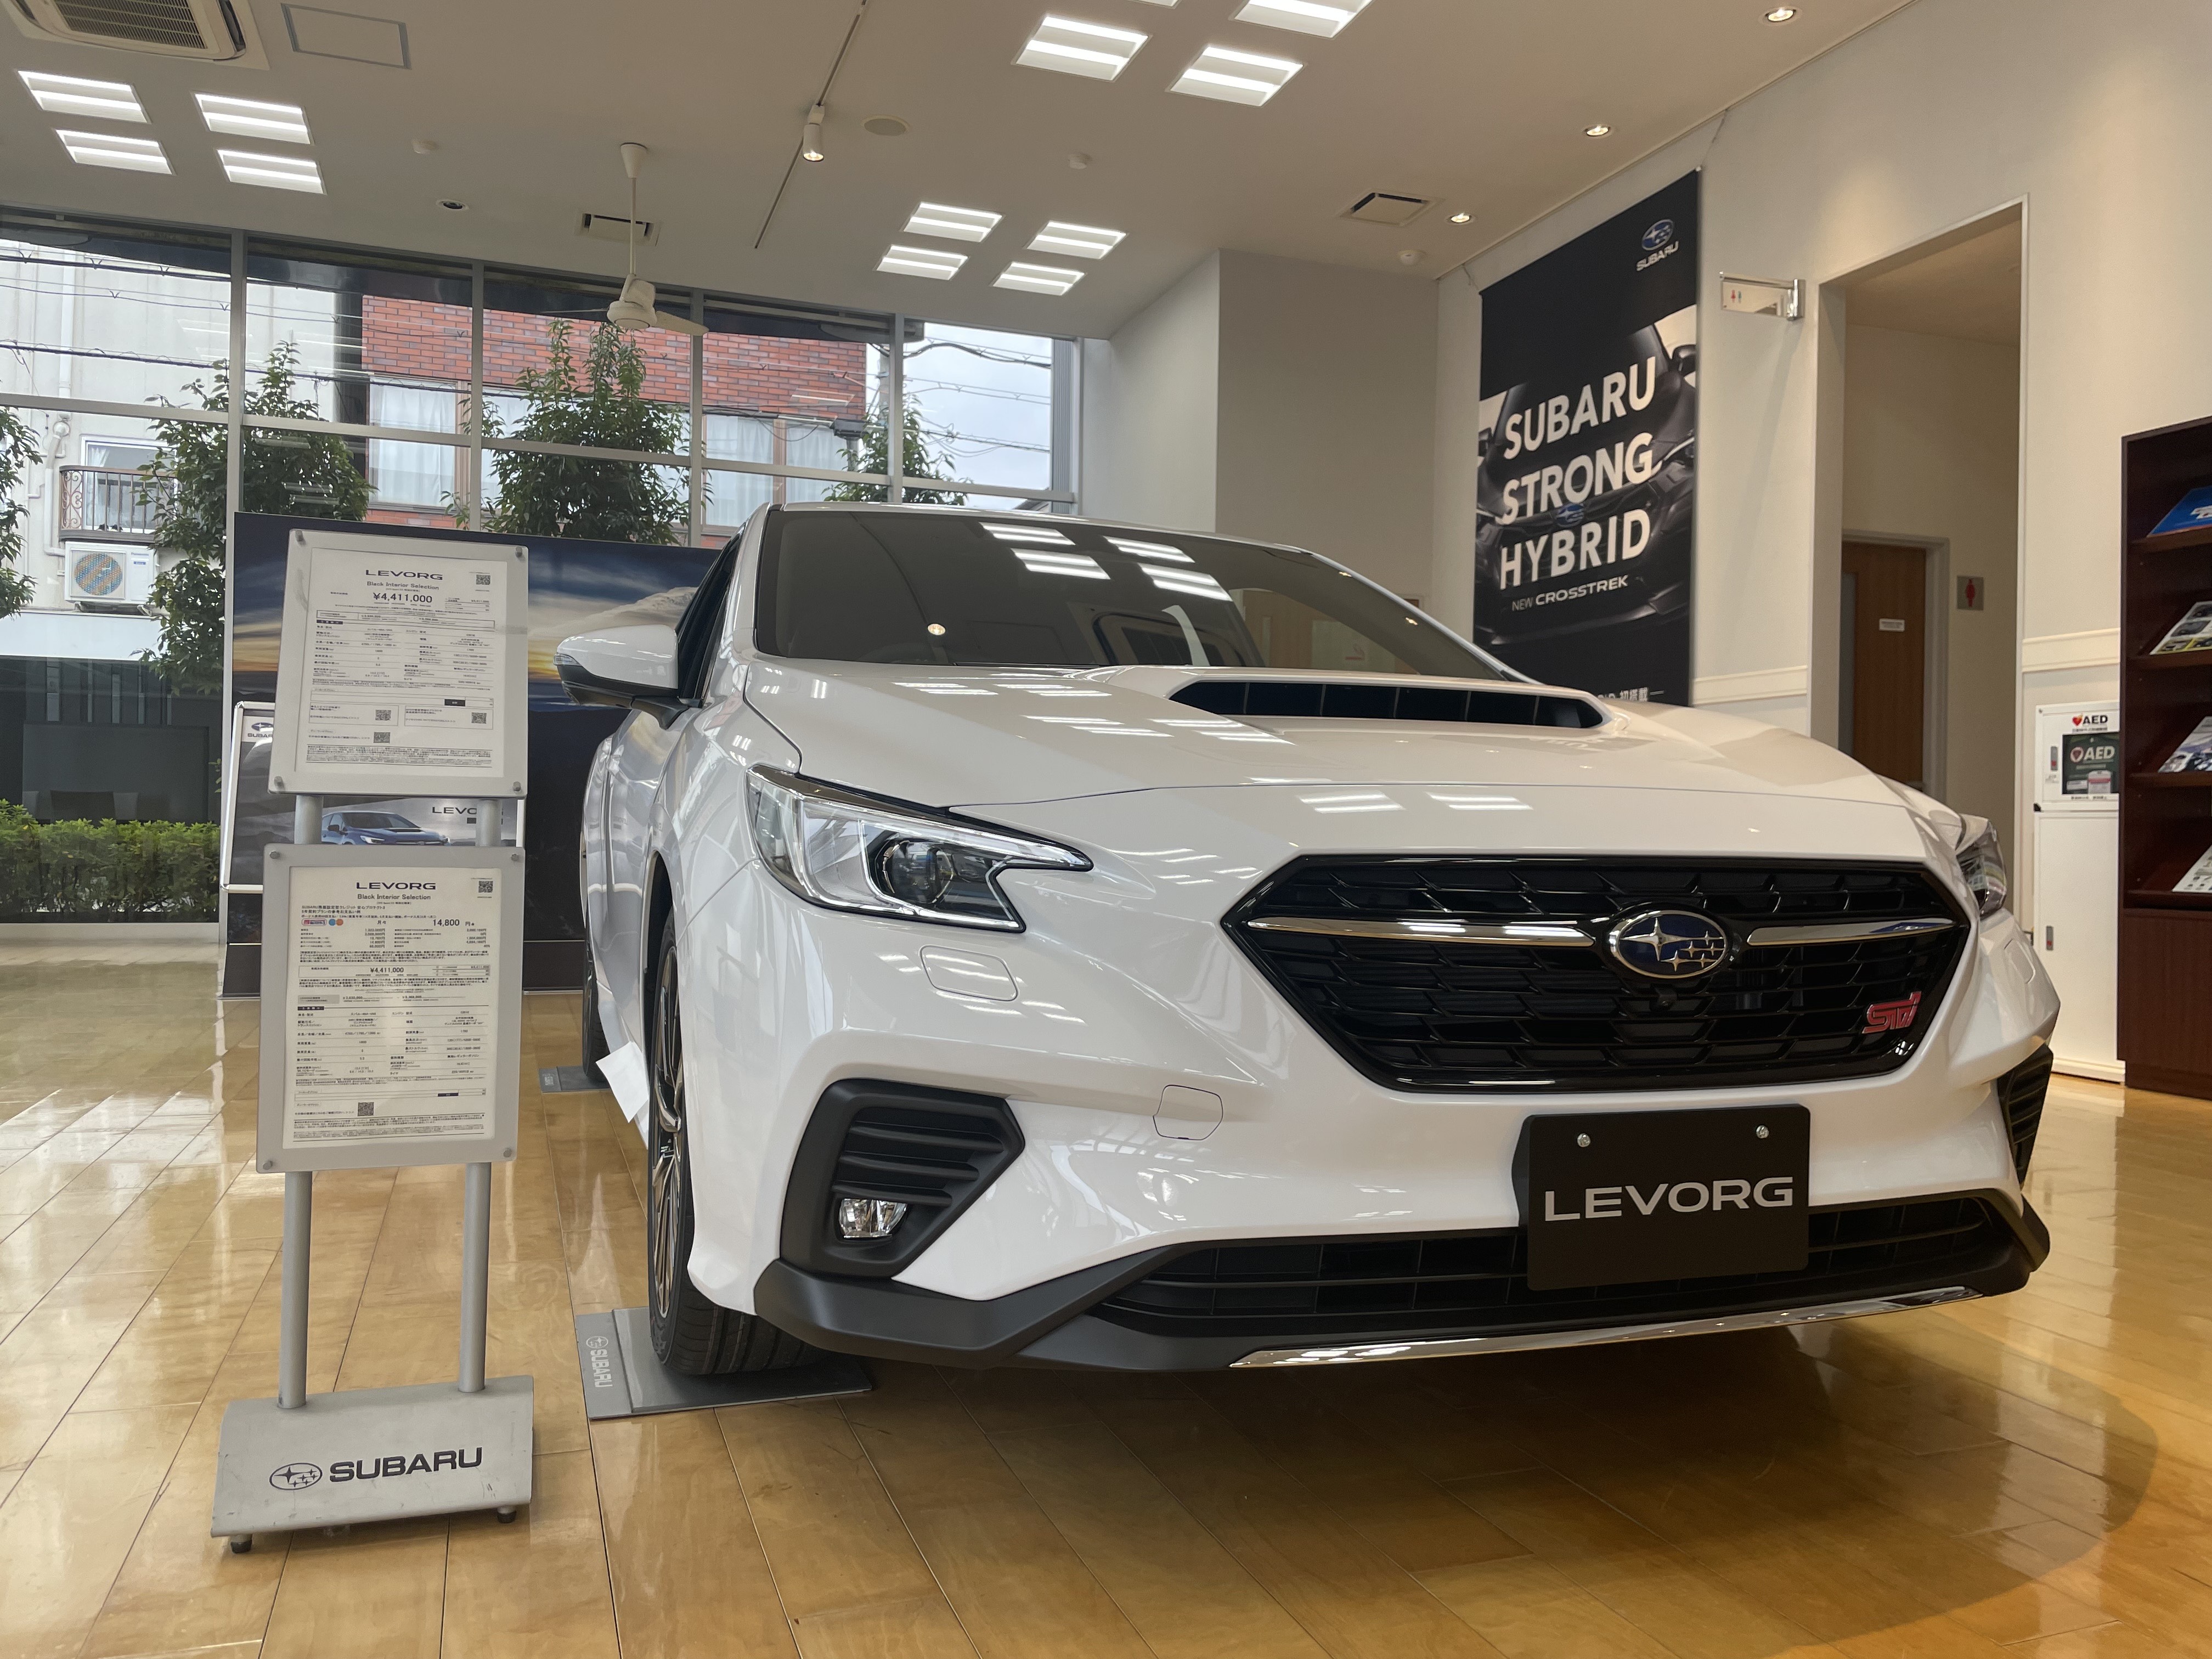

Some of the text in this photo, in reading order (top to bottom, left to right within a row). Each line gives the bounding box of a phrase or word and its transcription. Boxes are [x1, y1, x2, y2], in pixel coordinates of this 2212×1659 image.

[1636, 240, 1679, 272] SUBARU
[1504, 356, 1656, 460] SUBARU
[1500, 432, 1653, 525] STRONG
[1500, 508, 1651, 590] HYBRID
[365, 569, 443, 580] LEVORG
[373, 592, 433, 603] ¥4,411,000
[1512, 574, 1629, 612] NEW CROSSTREK
[2083, 714, 2108, 724] AED
[2084, 745, 2115, 761] AED
[356, 882, 436, 890] LEVORG
[432, 919, 460, 927] 14,800
[1545, 1176, 1793, 1222] LEVORG
[590, 1348, 613, 1387] SUBARU
[329, 1447, 483, 1483] SUBARU
